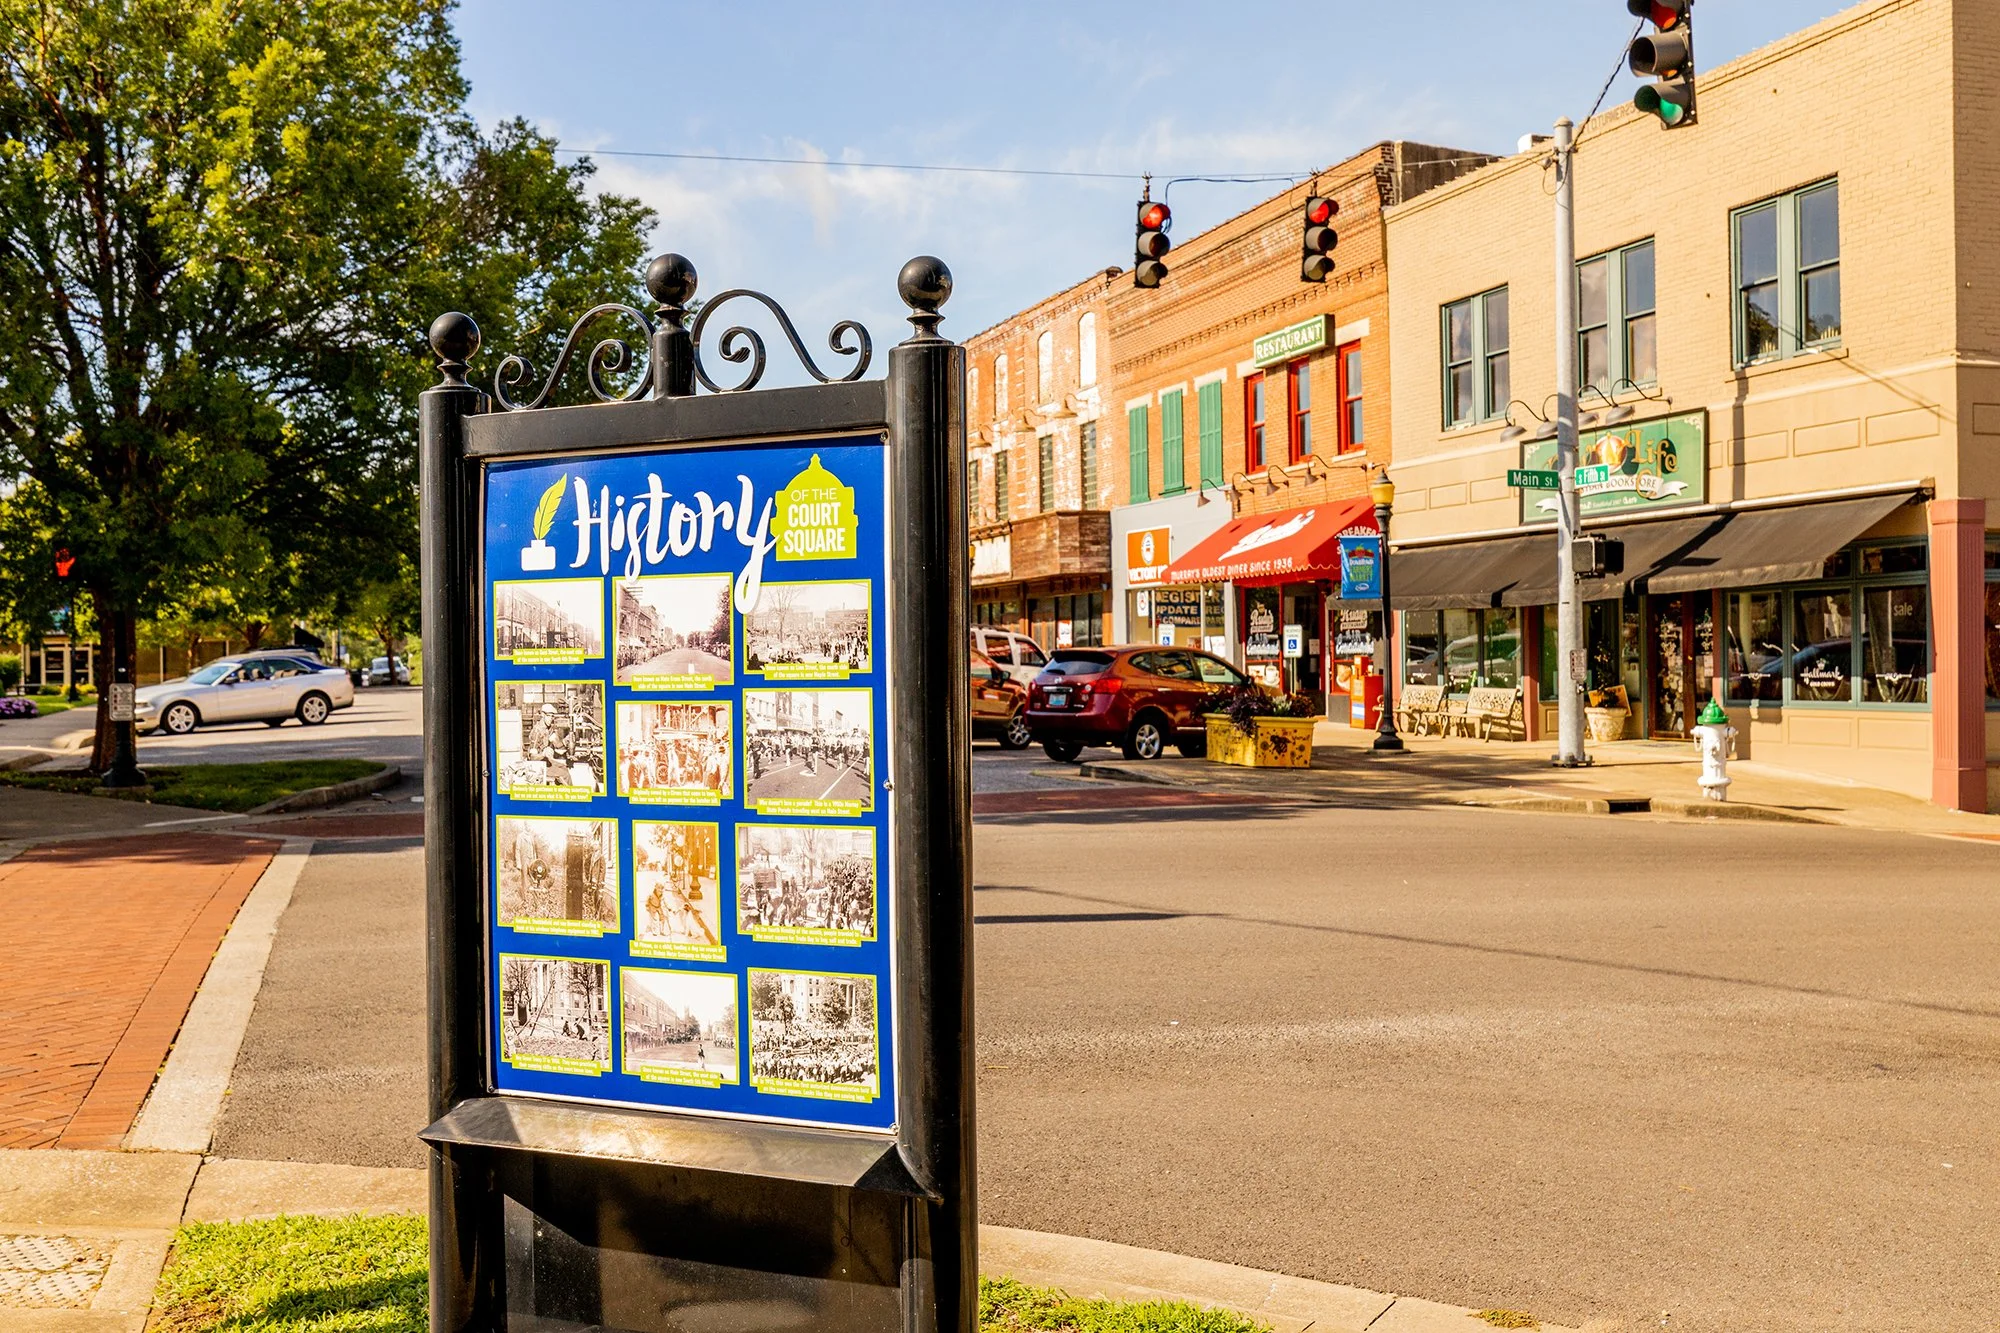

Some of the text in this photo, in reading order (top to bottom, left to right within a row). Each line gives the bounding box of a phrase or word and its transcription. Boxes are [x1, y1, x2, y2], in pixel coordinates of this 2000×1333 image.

[1256, 323, 1322, 358] RESTAURANT
[1624, 429, 1678, 478] Life
[1513, 471, 1553, 487] Main St
[1584, 468, 1599, 483] Fifth
[1600, 471, 1605, 481] St
[791, 487, 837, 502] OF THE
[788, 502, 841, 528] COURT
[569, 473, 780, 614] History
[784, 528, 845, 556] SQUARE
[1129, 566, 1157, 581] VICTORY
[1171, 569, 1200, 580] MURRAY'S
[1202, 566, 1226, 577] OLDEST
[1227, 564, 1248, 575] DINER
[1250, 560, 1271, 572] SINCE
[1273, 557, 1293, 568] 1936
[1893, 603, 1913, 616] sale
[1800, 666, 1844, 685] Hallmark
